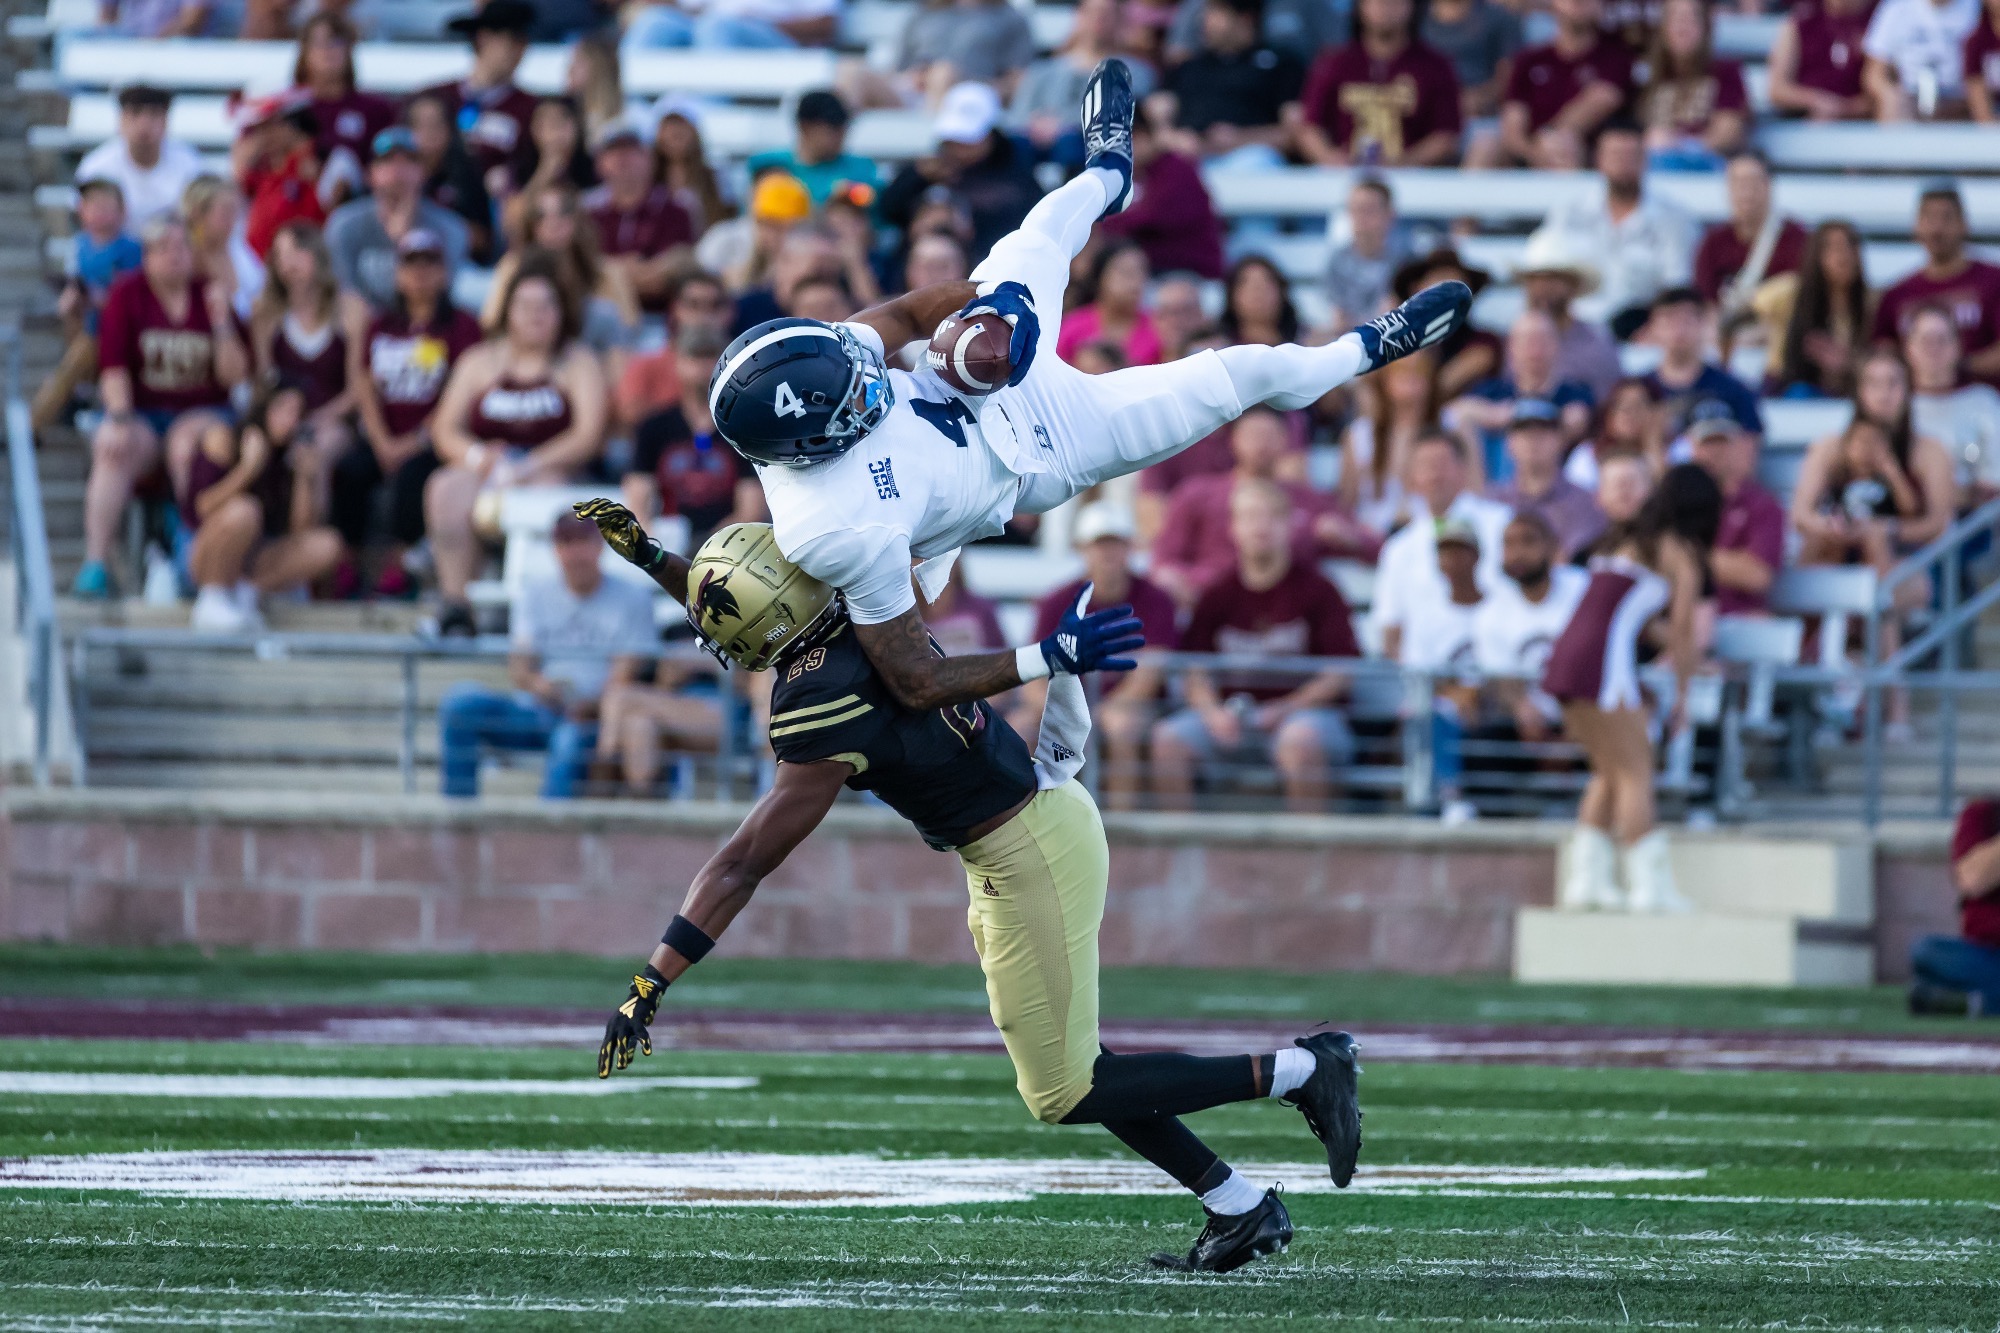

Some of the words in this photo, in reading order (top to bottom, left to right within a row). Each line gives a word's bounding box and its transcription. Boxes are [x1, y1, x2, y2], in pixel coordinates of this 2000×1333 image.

[774, 381, 807, 418] 4
[909, 396, 977, 447] 4
[868, 460, 892, 500] SBC
[763, 622, 790, 643] SBC
[787, 647, 827, 683] 29
[1051, 741, 1075, 757] adidas
